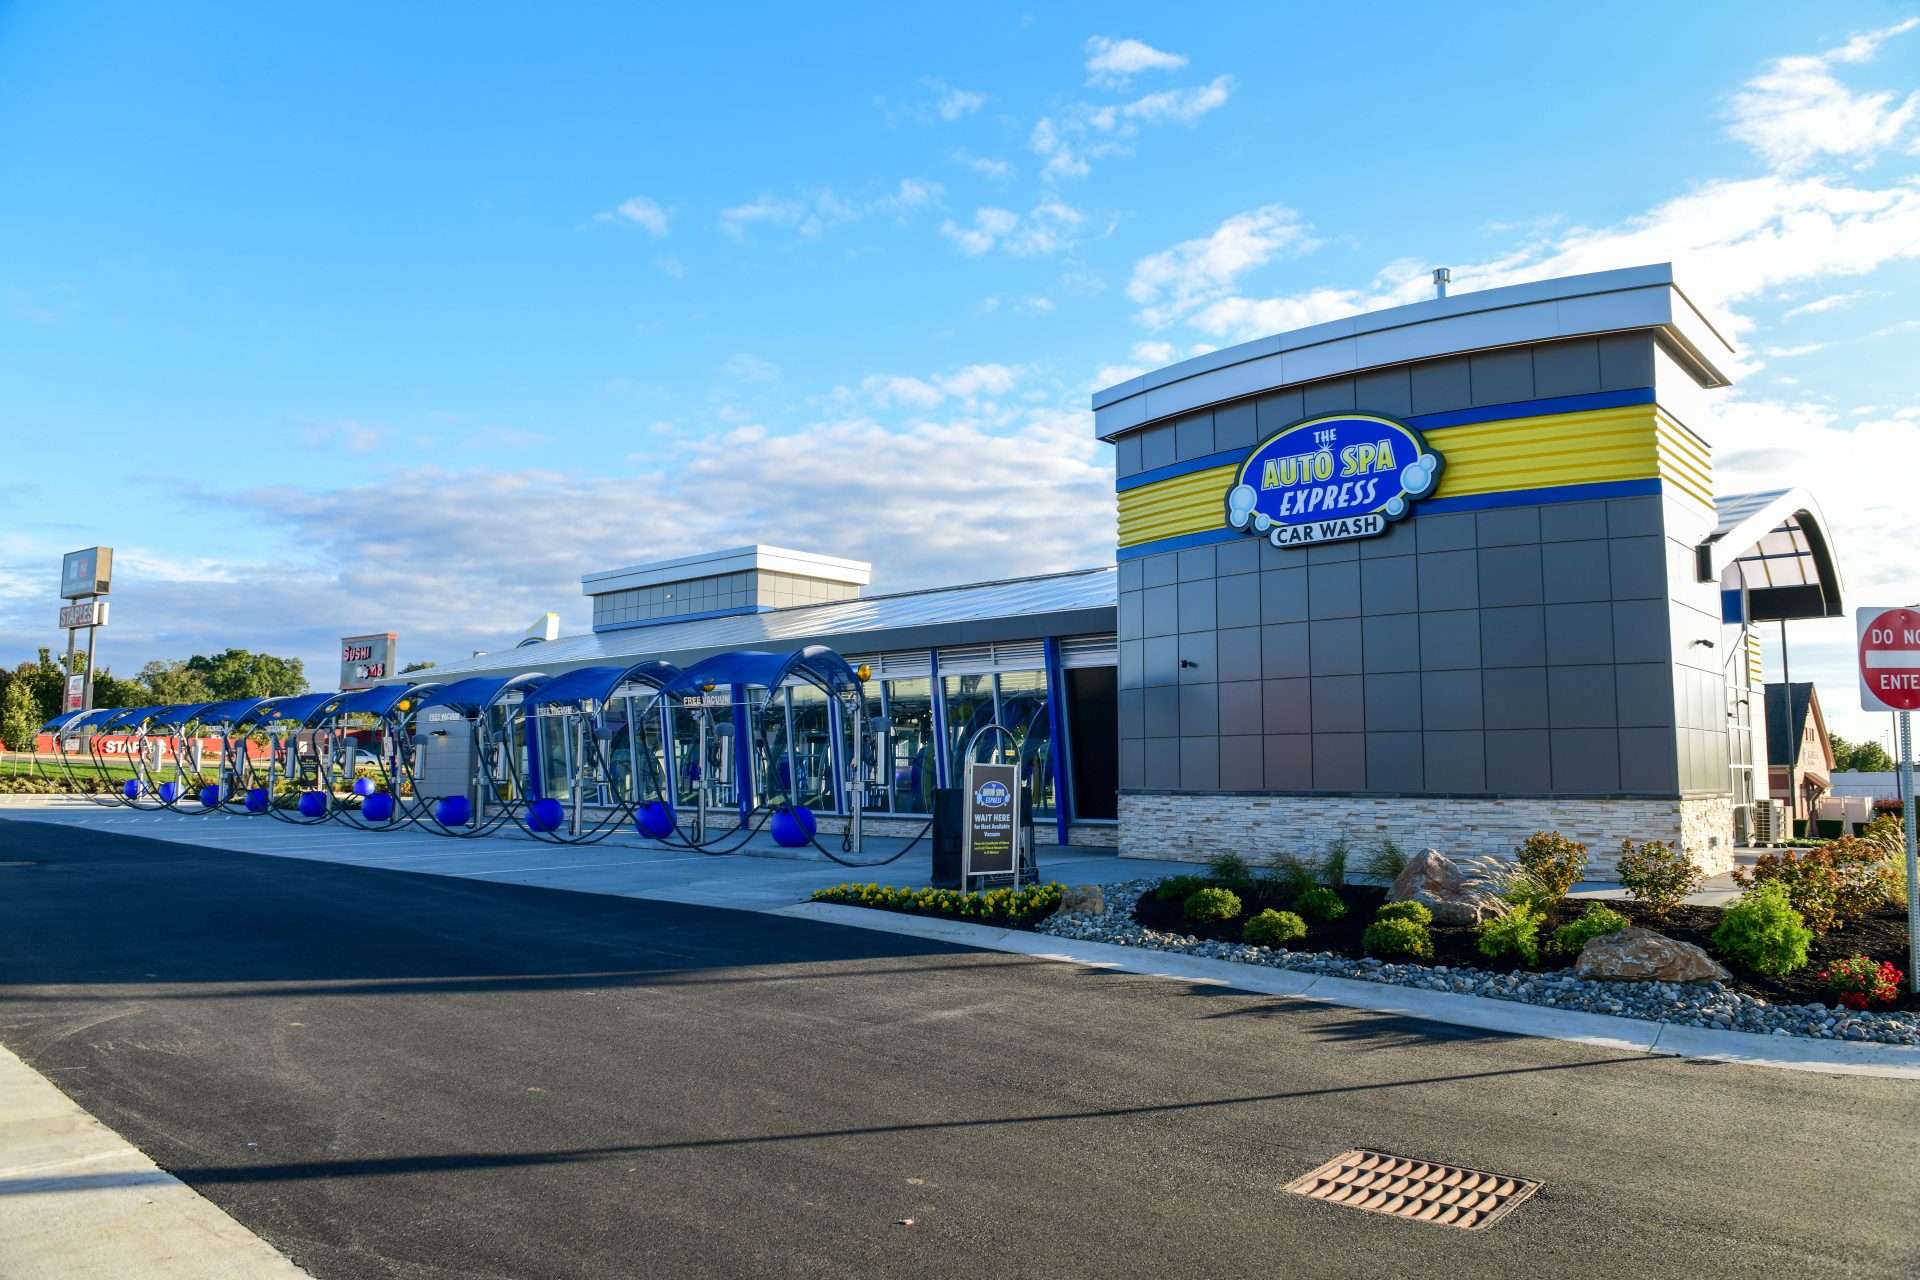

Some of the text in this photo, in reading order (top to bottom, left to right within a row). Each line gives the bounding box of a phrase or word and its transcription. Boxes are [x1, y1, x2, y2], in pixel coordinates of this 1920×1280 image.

[1313, 428, 1337, 444] THE
[1261, 439, 1397, 491] AUTO SPA
[1279, 477, 1379, 517] EXPRESS
[1277, 516, 1378, 544] CAR WASH
[61, 605, 93, 626] STAPLES
[1872, 629, 1893, 644] DO
[344, 647, 370, 661] SUSHI
[683, 696, 701, 705] FREE
[974, 814, 1010, 822] WAIT HERE
